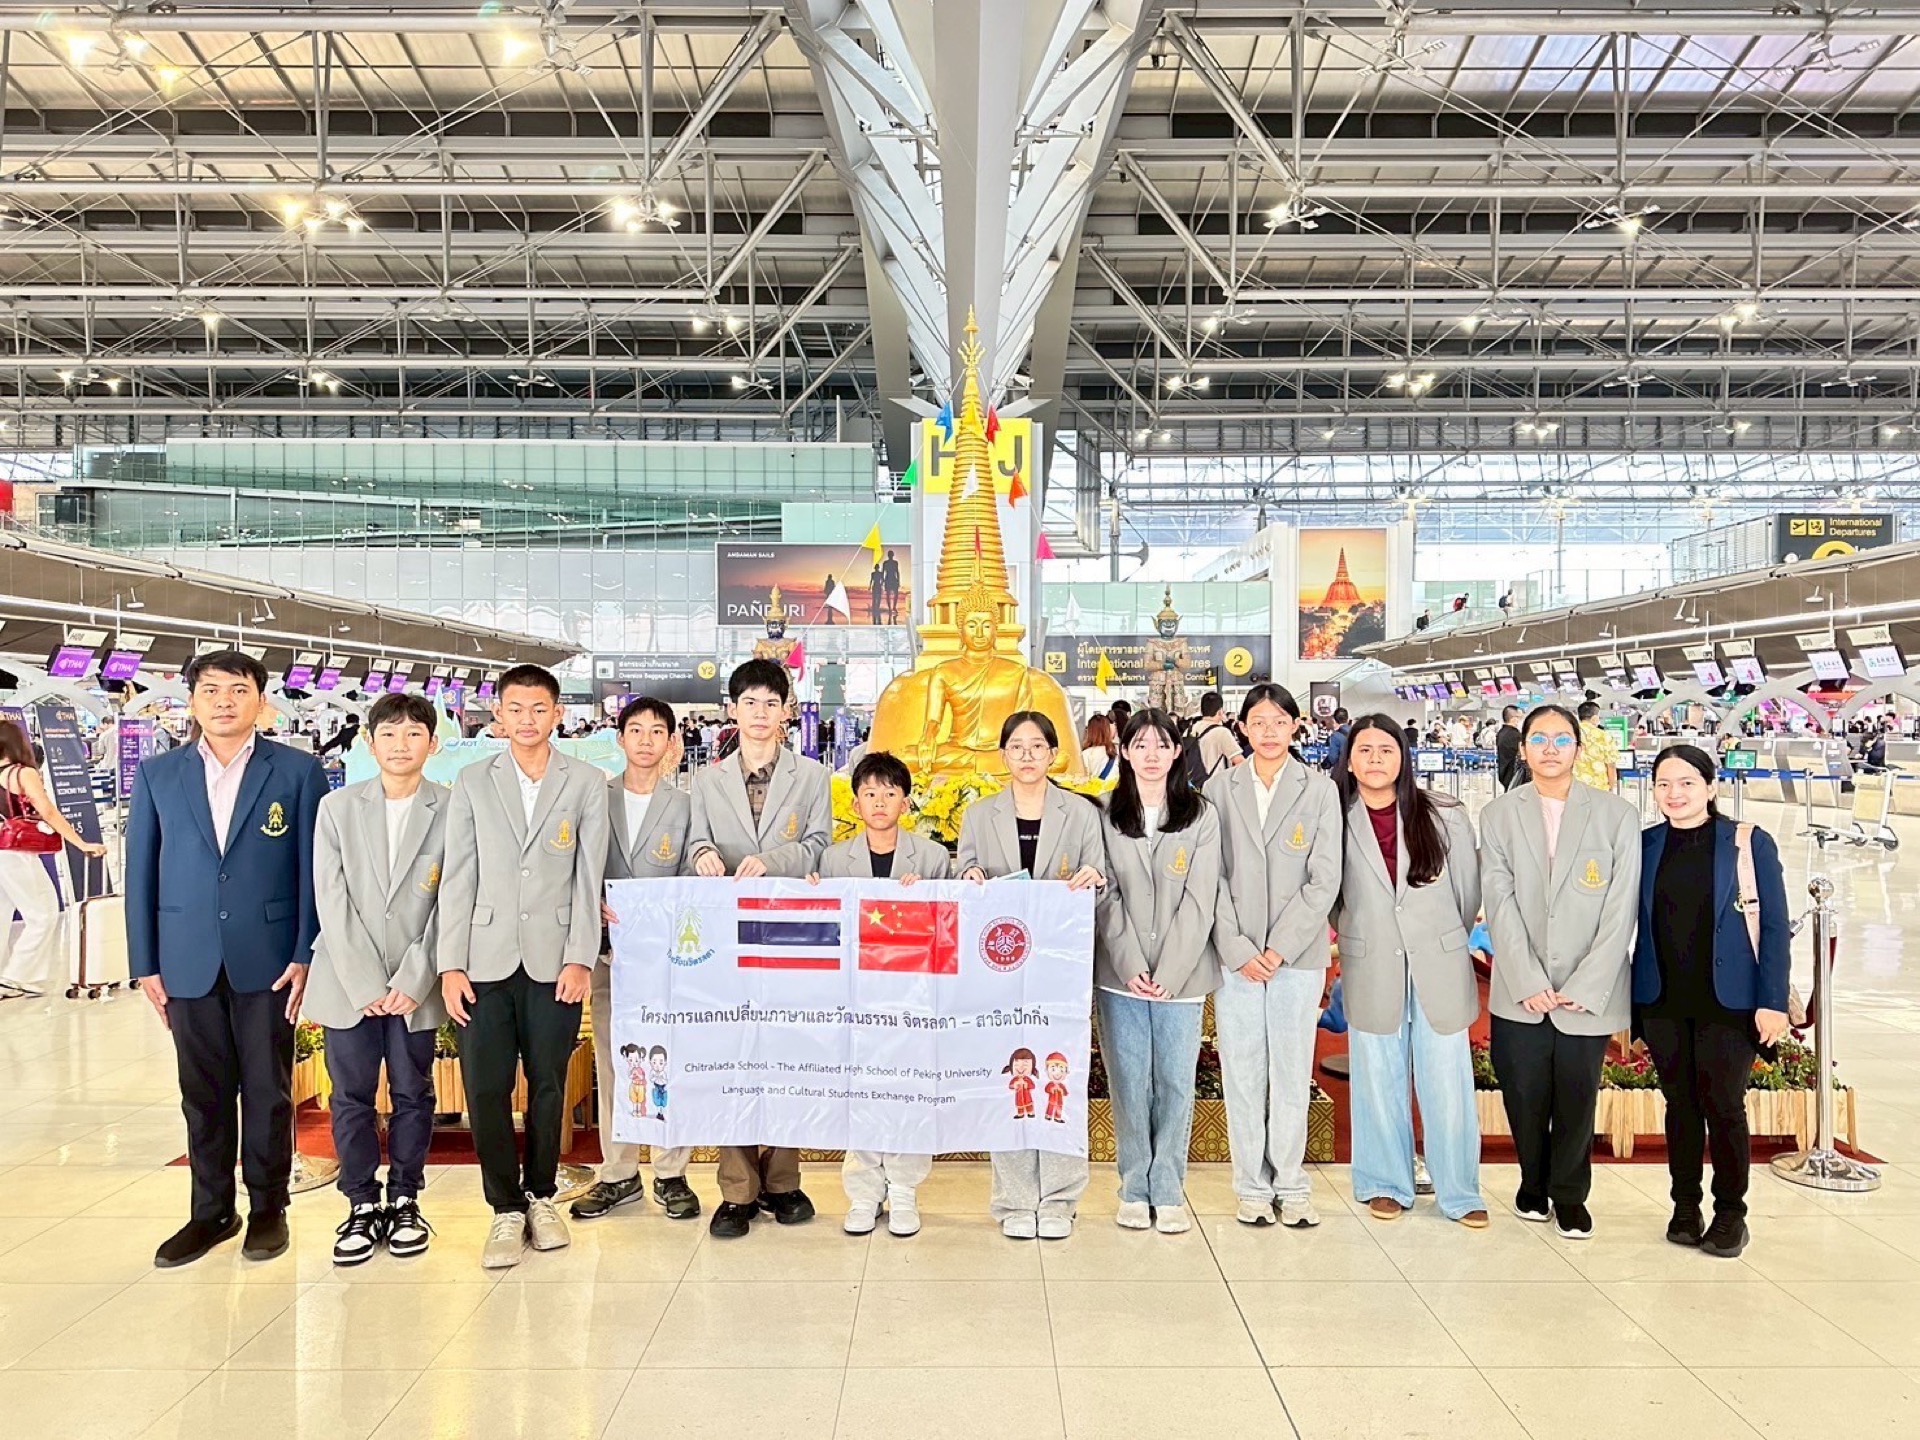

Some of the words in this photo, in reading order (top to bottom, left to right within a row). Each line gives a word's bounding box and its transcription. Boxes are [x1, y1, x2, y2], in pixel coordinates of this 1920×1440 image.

[997, 435, 1023, 477] J
[1829, 518, 1882, 527] International
[1829, 528, 1877, 538] Departures
[1077, 659, 1144, 669] Inteational
[1233, 654, 1243, 668] 2
[644, 672, 668, 681] Baggage
[669, 672, 694, 680] Check-in
[701, 666, 713, 676] Y2
[640, 999, 898, 1027] โครงการแลกเปลี่ยนภาษาและวัฒนธรรม
[902, 1010, 957, 1030] จิตรลดา
[975, 1005, 1050, 1028] สาธิตปักกิ่ง
[684, 1061, 735, 1073] Chitralada
[737, 1060, 769, 1071] School
[777, 1061, 796, 1072] The
[797, 1062, 842, 1074] Affiliated
[844, 1064, 863, 1076] High
[866, 1065, 898, 1076] School
[900, 1067, 911, 1078] of
[913, 1069, 942, 1081] Peking
[944, 1067, 992, 1079] University
[722, 1084, 765, 1097] Language
[767, 1085, 786, 1095] and
[788, 1086, 826, 1098] Cultural
[828, 1088, 869, 1099] Students
[871, 1091, 915, 1103] Exchange
[917, 1093, 956, 1106] Program
